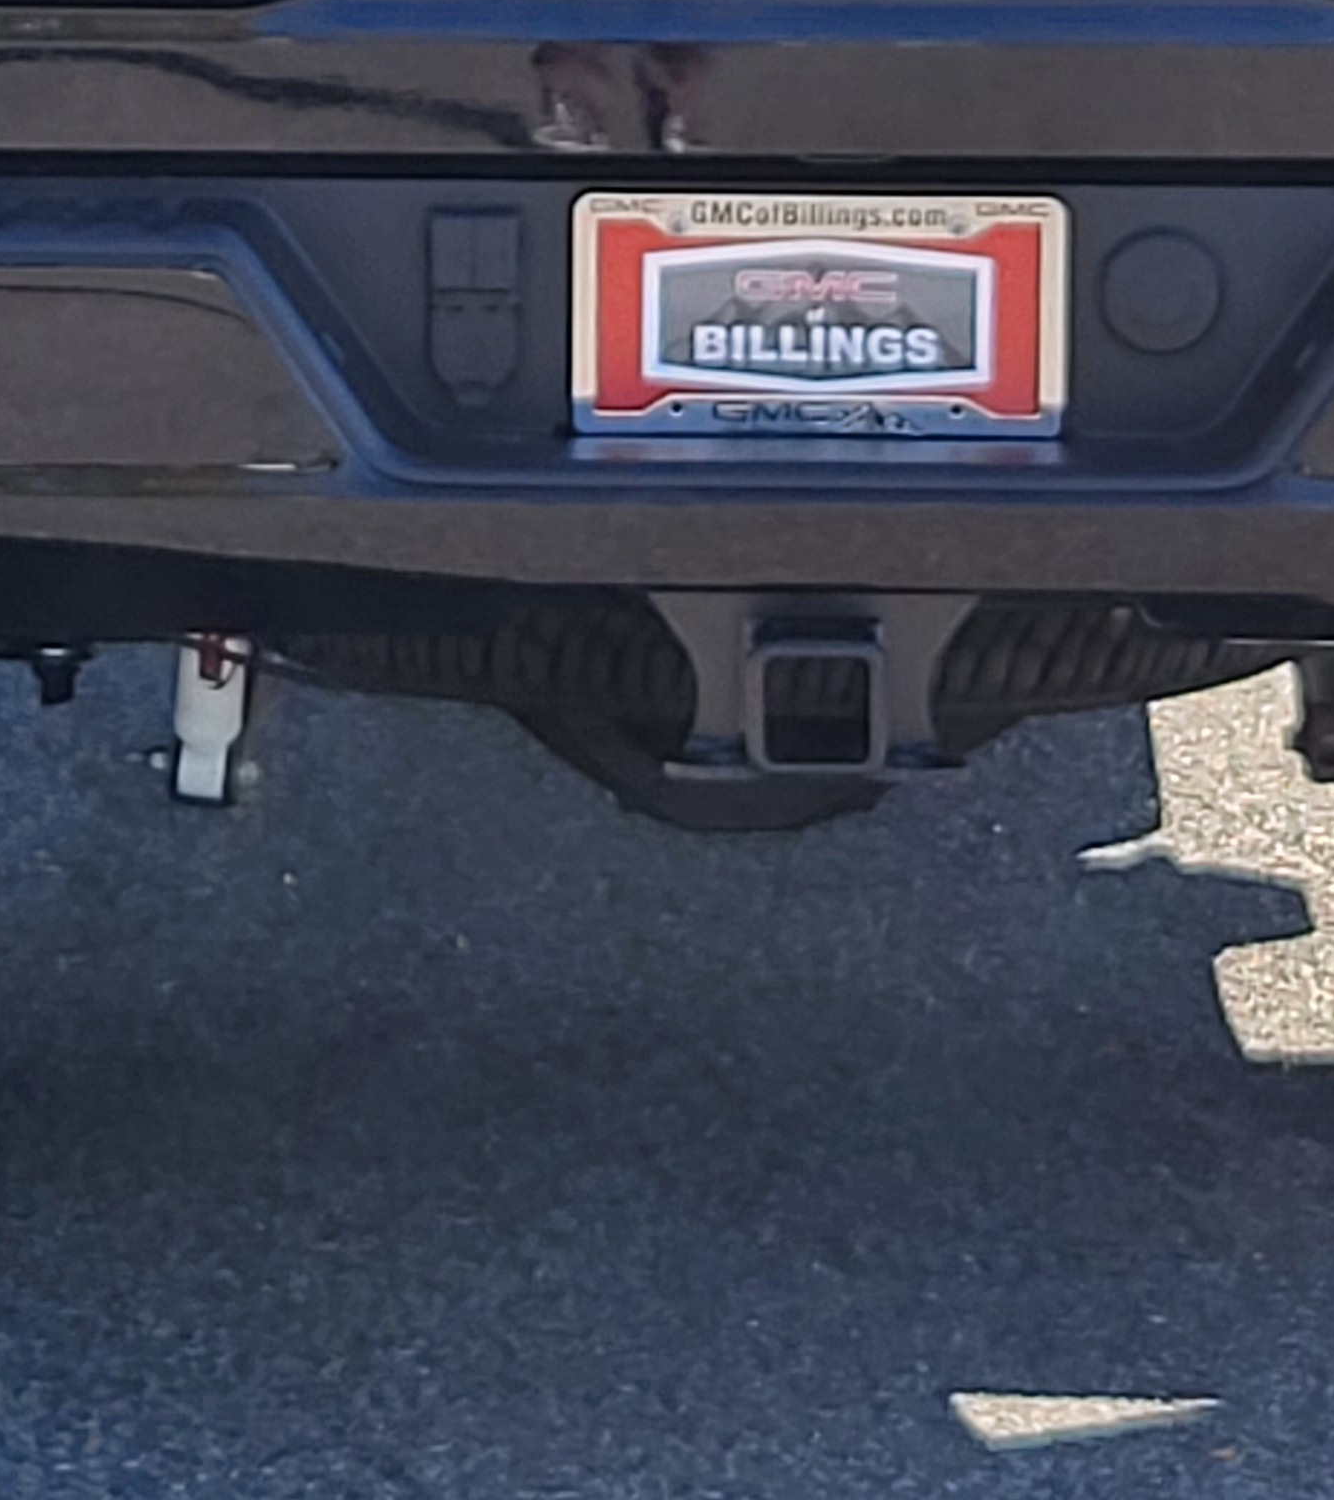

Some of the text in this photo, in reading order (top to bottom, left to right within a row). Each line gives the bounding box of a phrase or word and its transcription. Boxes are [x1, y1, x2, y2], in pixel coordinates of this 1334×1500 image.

[690, 201, 947, 230] GMCofBillings.com
[735, 270, 898, 301] GMC
[693, 324, 939, 365] BILLINGS
